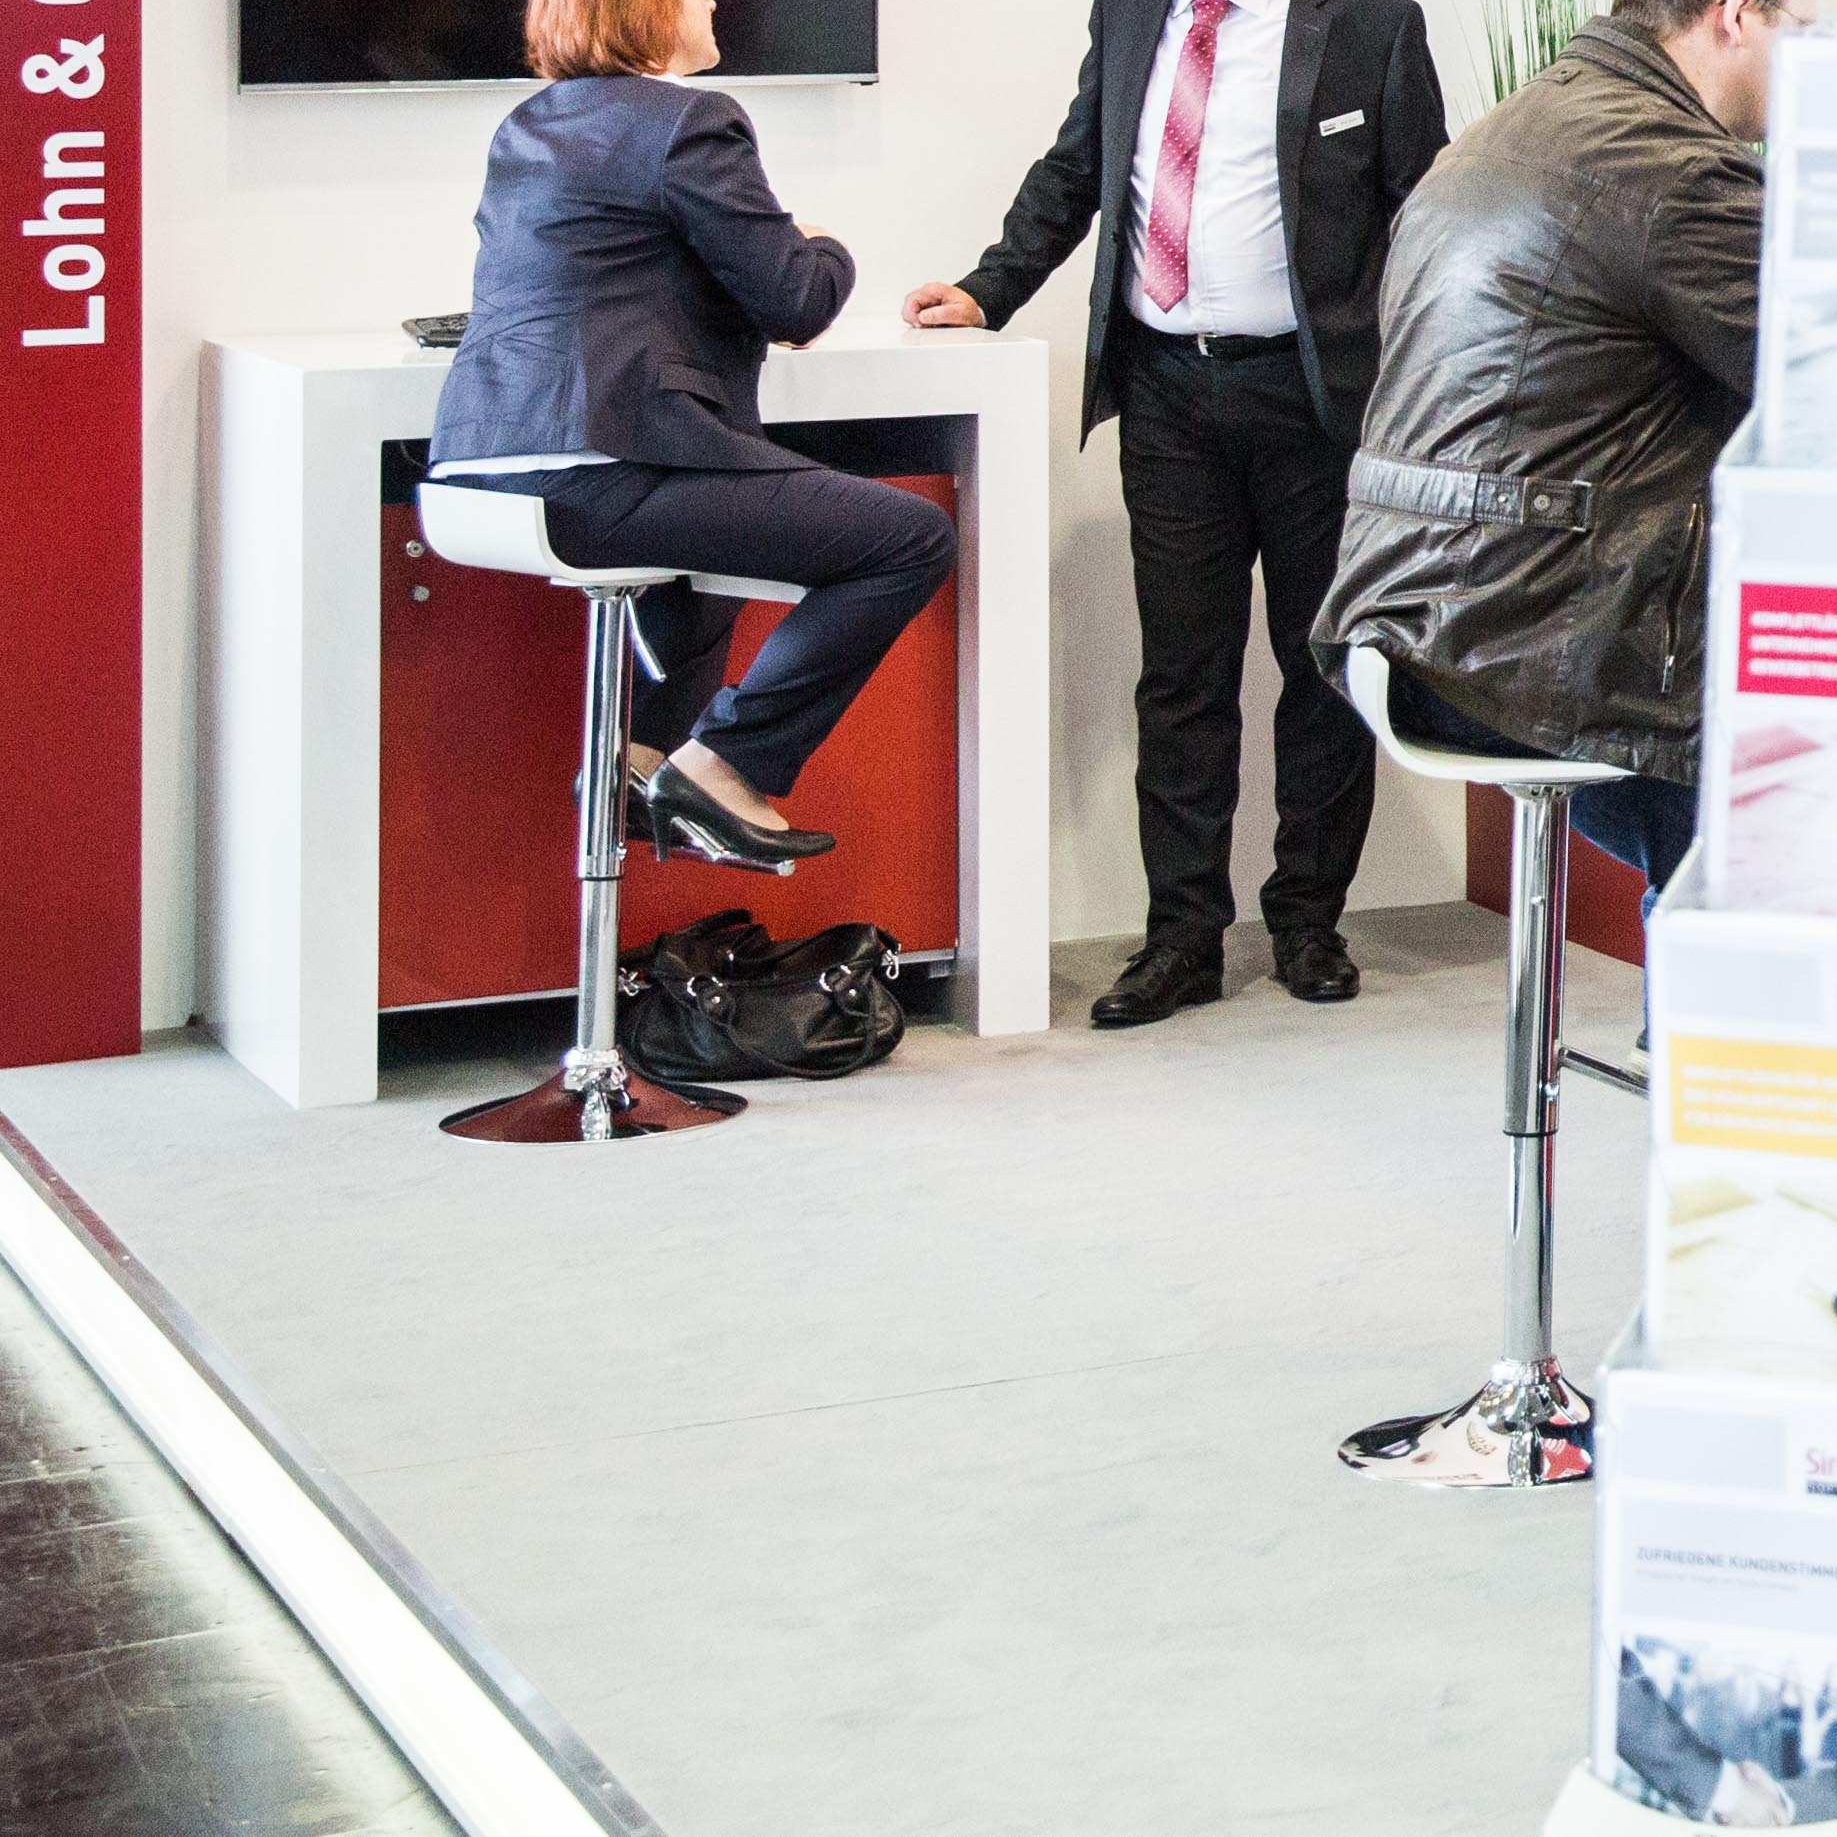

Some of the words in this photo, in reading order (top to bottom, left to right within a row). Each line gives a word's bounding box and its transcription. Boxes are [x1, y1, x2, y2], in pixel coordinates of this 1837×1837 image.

[22, 34, 105, 99] &
[23, 131, 105, 346] Lohn
[1636, 1545, 1725, 1569] ZUFRIEDENE
